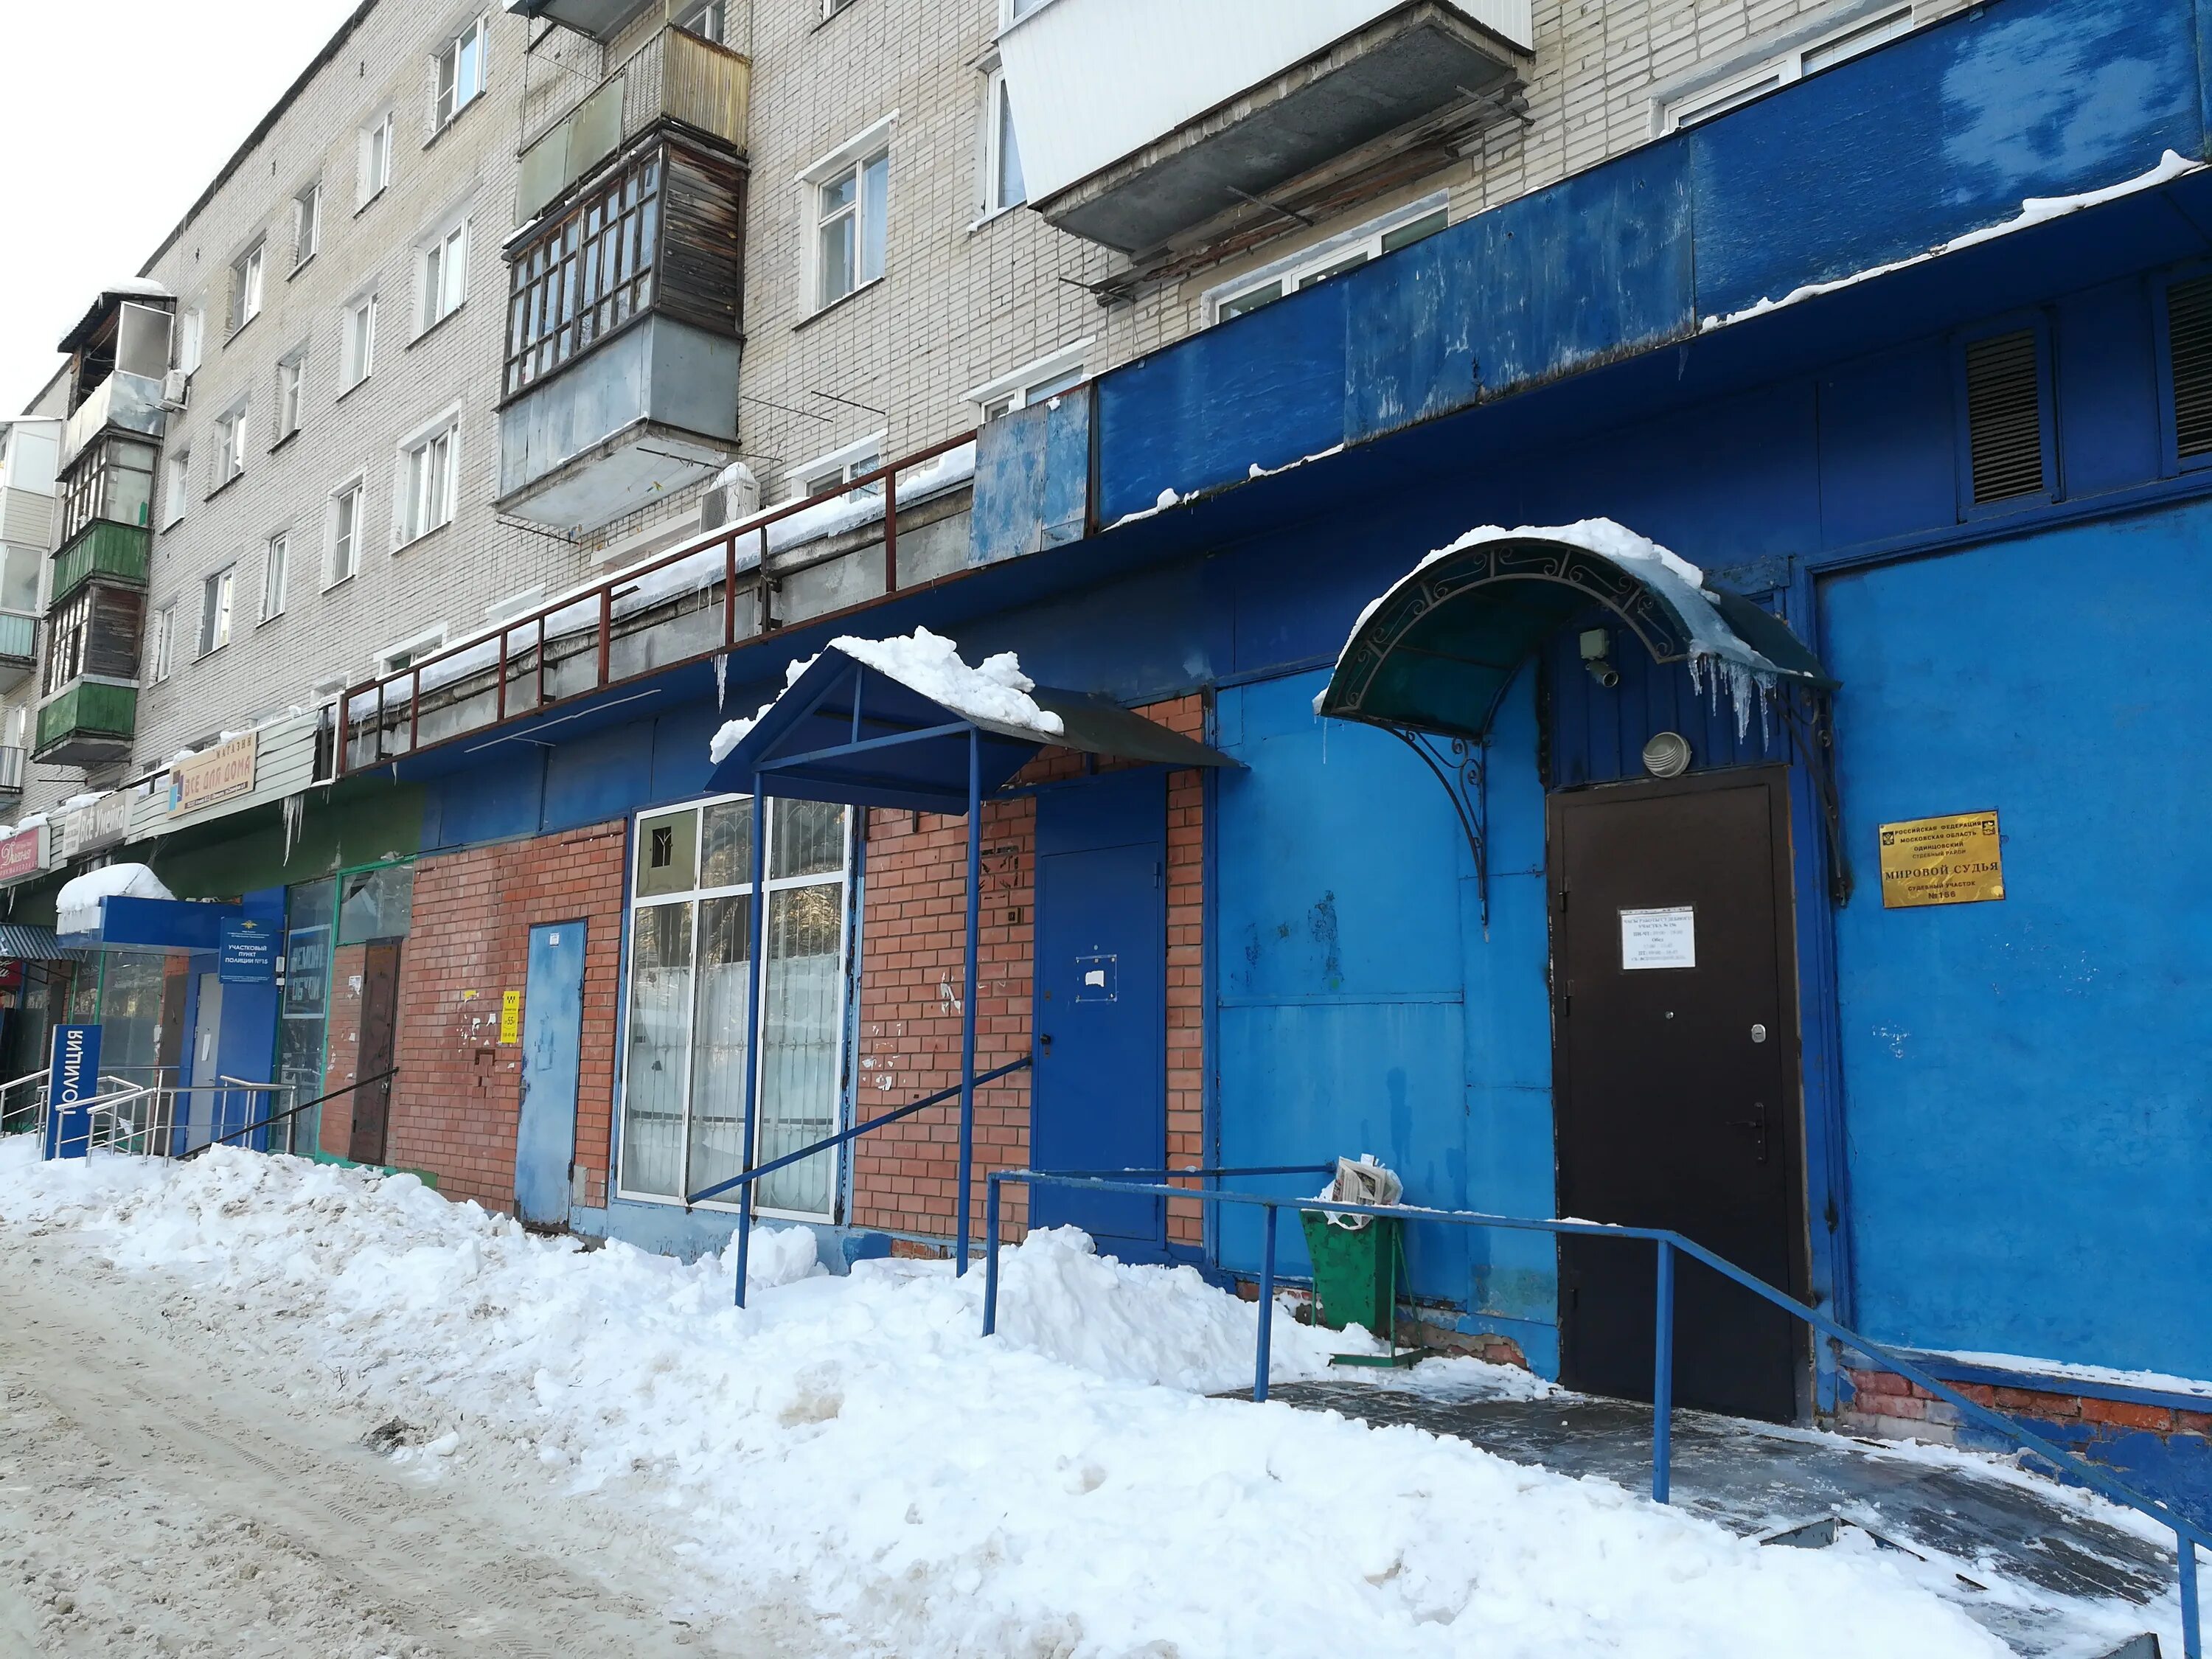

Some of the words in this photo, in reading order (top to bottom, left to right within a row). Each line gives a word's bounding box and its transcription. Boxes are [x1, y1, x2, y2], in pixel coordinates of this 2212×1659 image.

[184, 775, 201, 797] ВСЕ
[203, 767, 221, 790] ДЛЯ
[223, 755, 251, 782] ДОМА
[1894, 826, 1938, 835] РОССИЙСКАЯ
[1941, 821, 1982, 830] ФЕДЕРАЦИЯ
[1900, 835, 1945, 844] МОСКОВСКАЯ
[1946, 830, 1977, 838] ОБЛАСТЬ
[1912, 851, 1944, 859] СУДЕБНЫЙ
[1946, 848, 1966, 856] РАЙОН
[1913, 841, 1964, 852] ОДИНЦОВСКИЙ
[1885, 864, 1949, 880] МИРОВОЙ
[1954, 862, 1999, 874] СУДЬЯ
[1907, 883, 1944, 891] СУДЕБНЫЙ
[1945, 880, 1976, 888] УЧАСТОК
